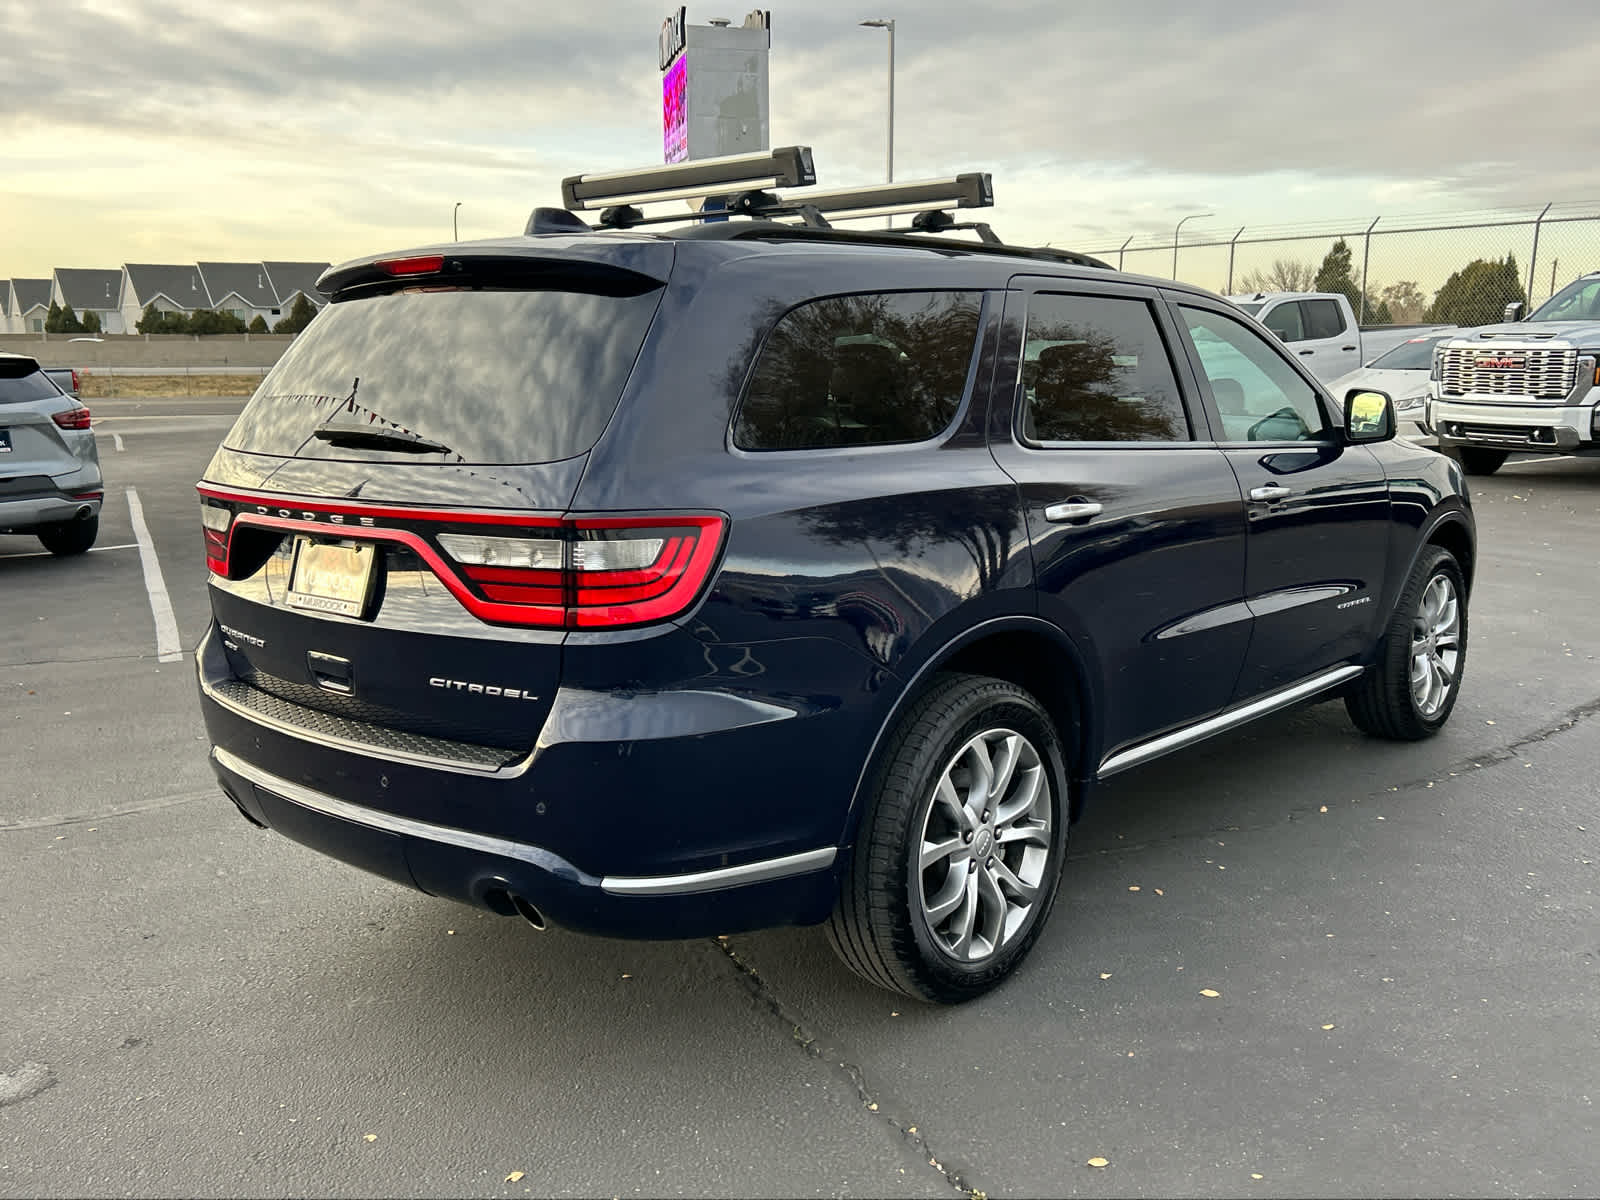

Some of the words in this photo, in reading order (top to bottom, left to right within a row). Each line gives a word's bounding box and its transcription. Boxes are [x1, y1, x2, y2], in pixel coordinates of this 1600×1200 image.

[1475, 356, 1525, 368] GMC
[256, 505, 375, 527] DODGE
[429, 677, 539, 700] CITADEL
